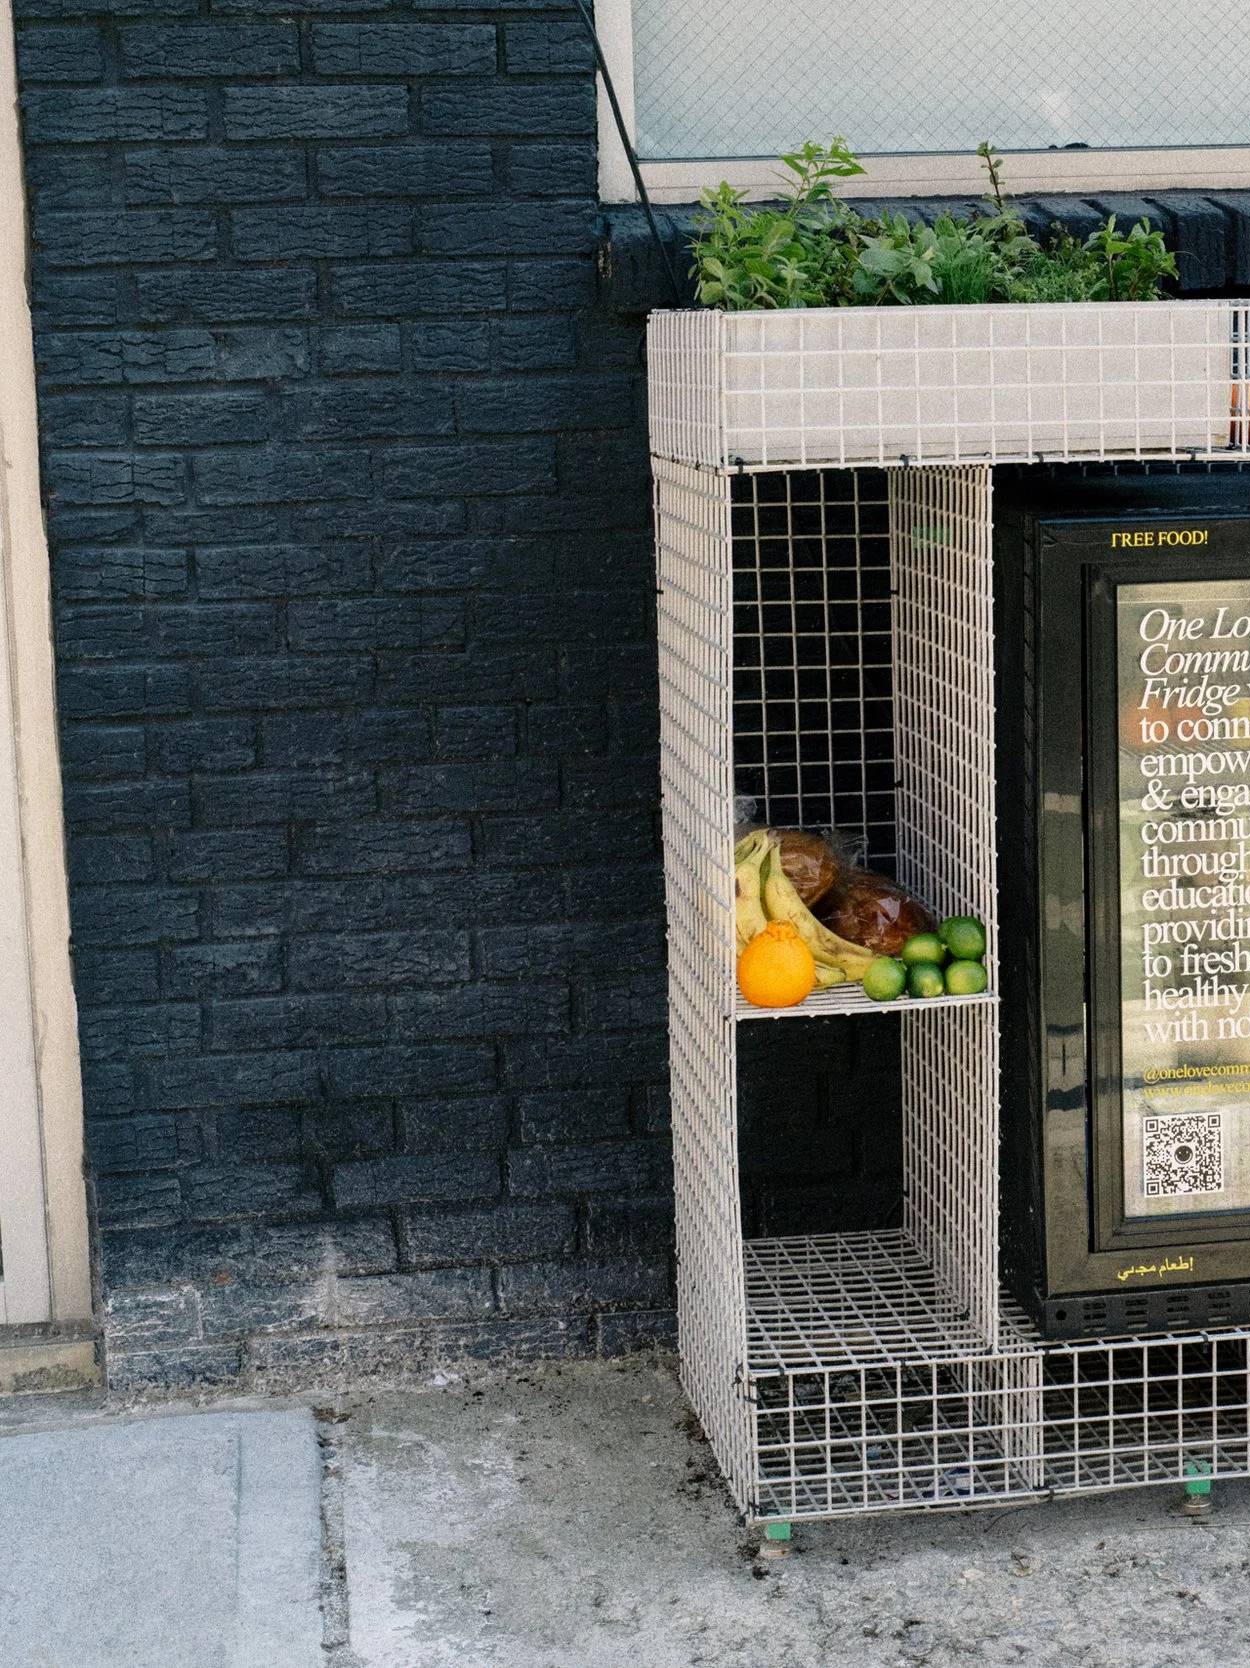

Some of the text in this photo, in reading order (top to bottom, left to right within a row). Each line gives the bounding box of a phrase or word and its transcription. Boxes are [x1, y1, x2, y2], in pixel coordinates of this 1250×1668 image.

[1157, 530, 1208, 546] FOOD!
[1139, 608, 1204, 643] One
[1138, 677, 1240, 717] Fridge
[1139, 713, 1170, 744] to
[1141, 780, 1173, 811] &
[1143, 949, 1172, 978] to
[1144, 977, 1248, 1014] healthy
[1145, 1011, 1209, 1044] with
